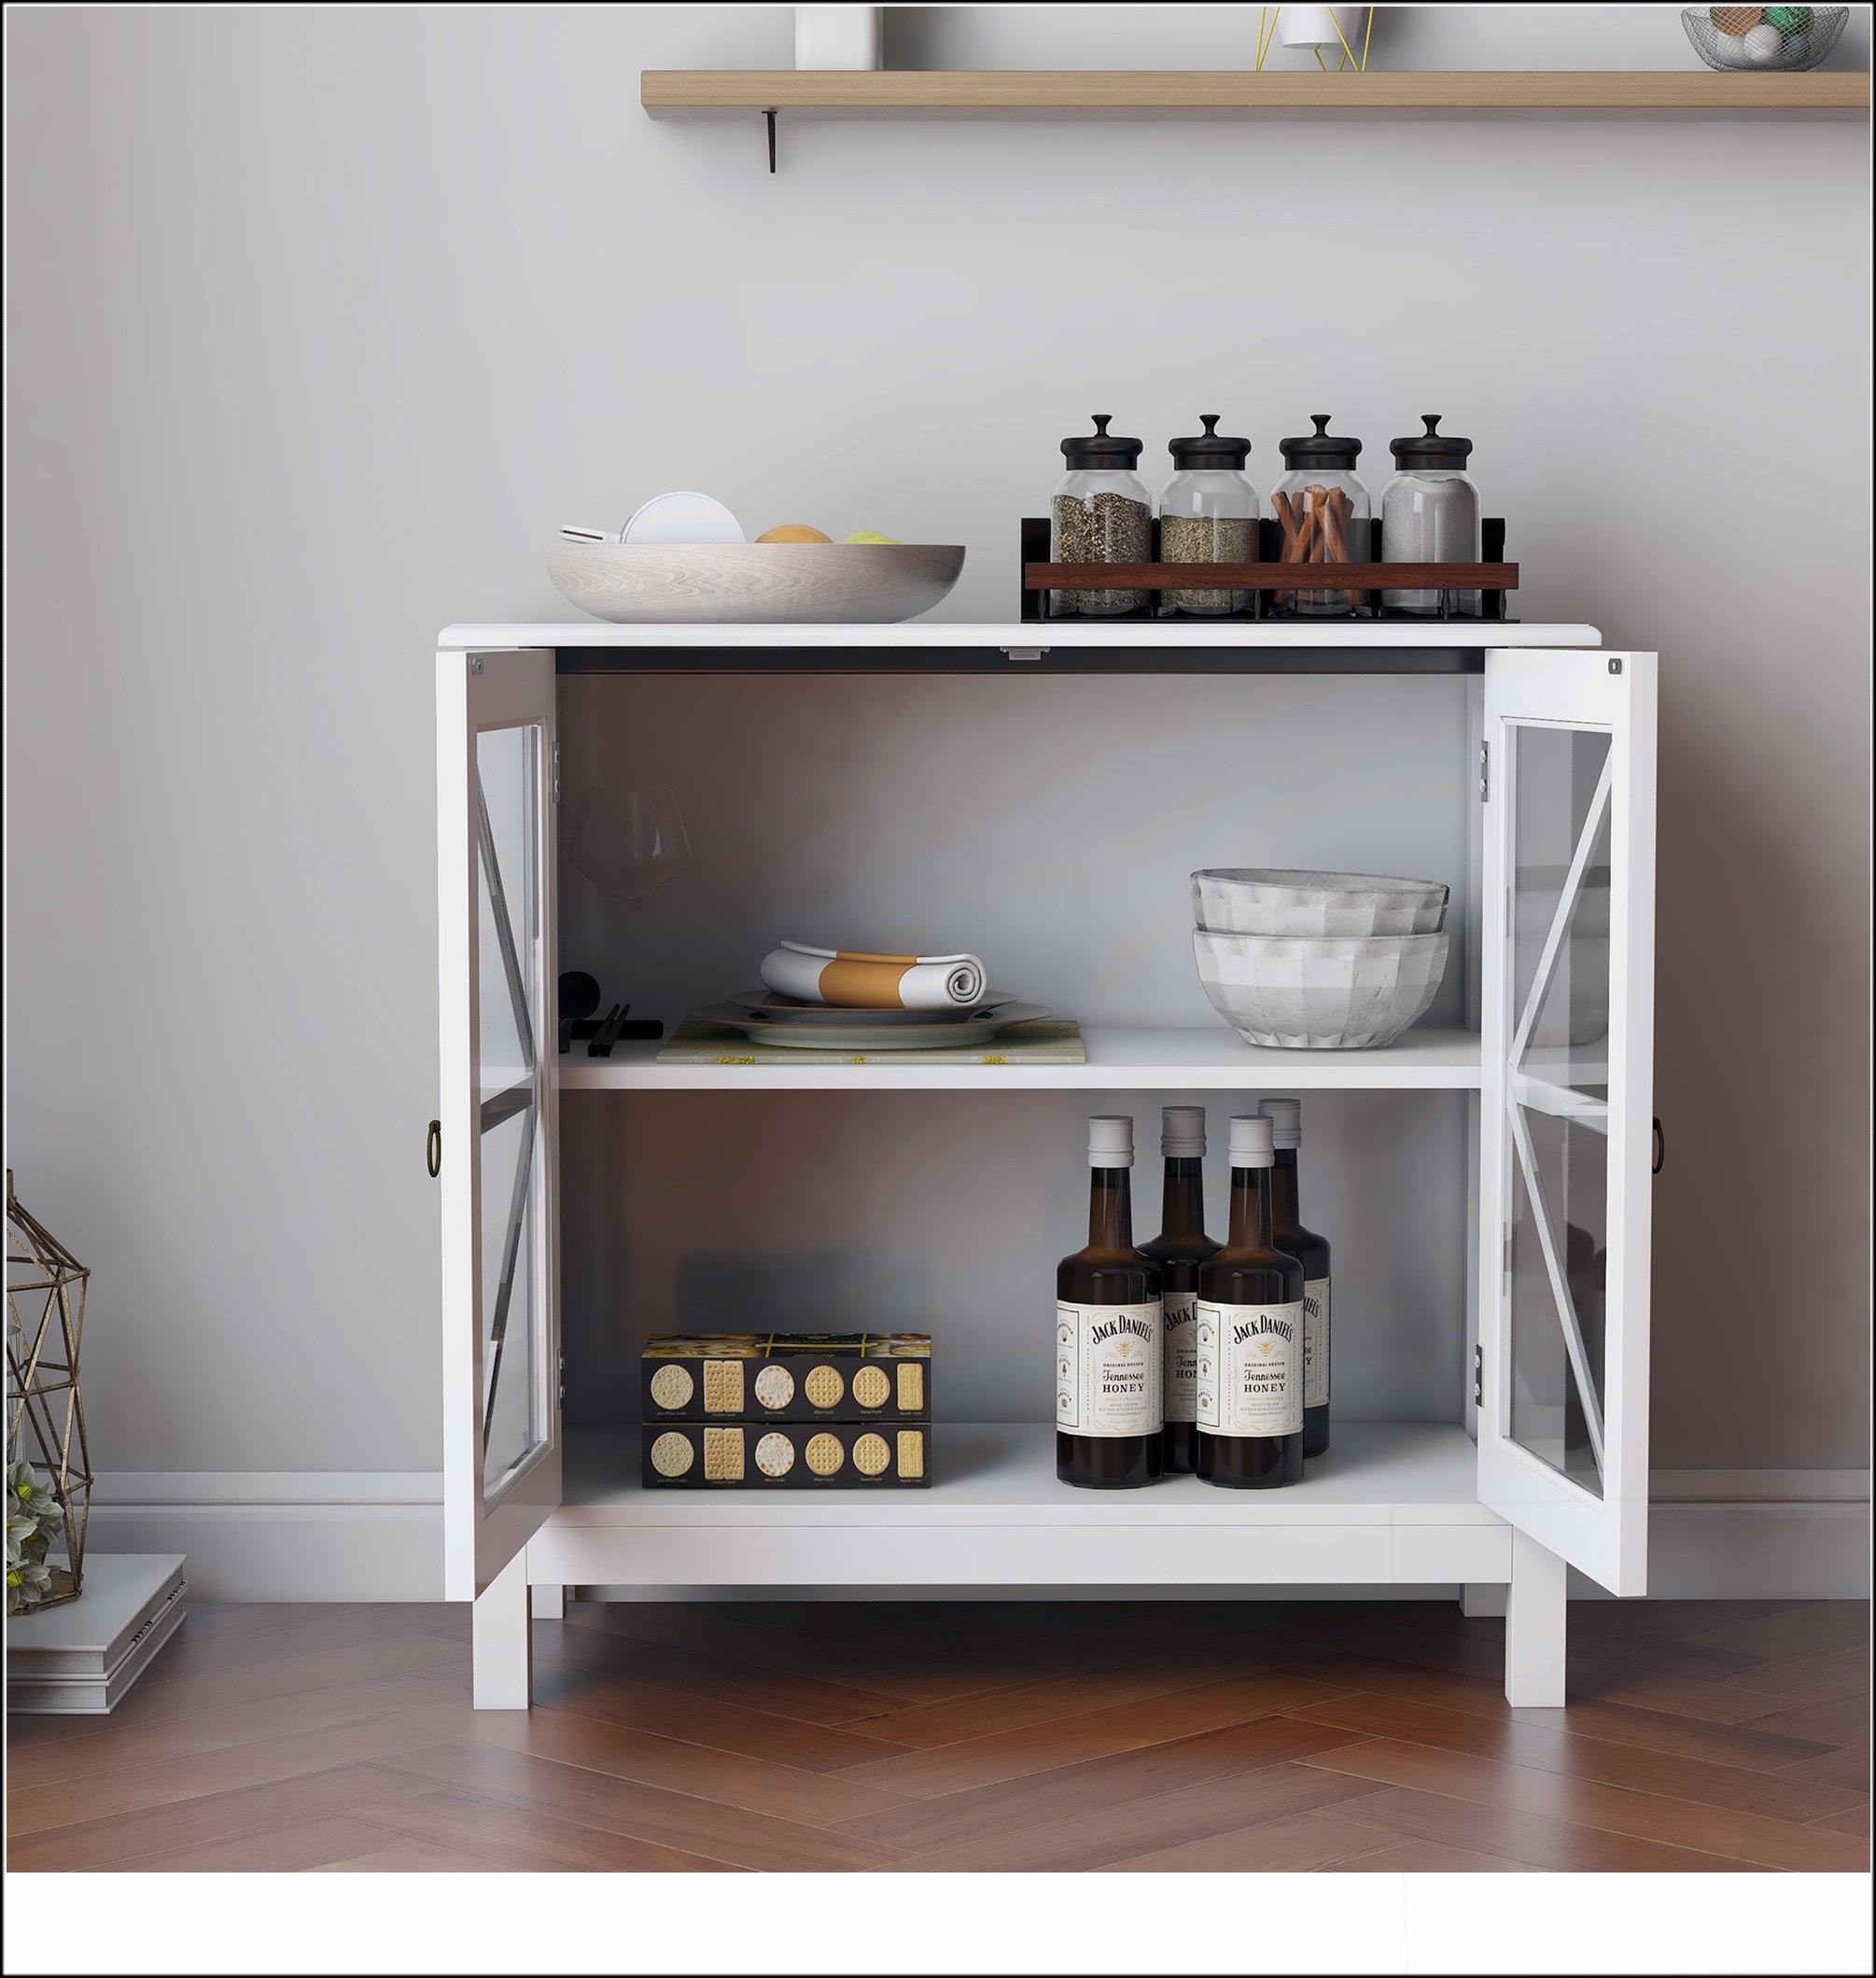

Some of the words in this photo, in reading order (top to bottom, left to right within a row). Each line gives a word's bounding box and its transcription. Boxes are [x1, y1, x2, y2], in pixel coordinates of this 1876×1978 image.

[1166, 1307, 1191, 1331] JACK
[1092, 1320, 1118, 1345] JACK
[1119, 1314, 1153, 1343] DANIEL'S
[1233, 1320, 1259, 1345] JACK
[1260, 1314, 1295, 1343] DANIEL'S
[1102, 1369, 1145, 1382] Tennessee
[1243, 1368, 1286, 1382] Tennessee
[1102, 1382, 1145, 1394] HONEY
[1243, 1382, 1286, 1394] HONEY
